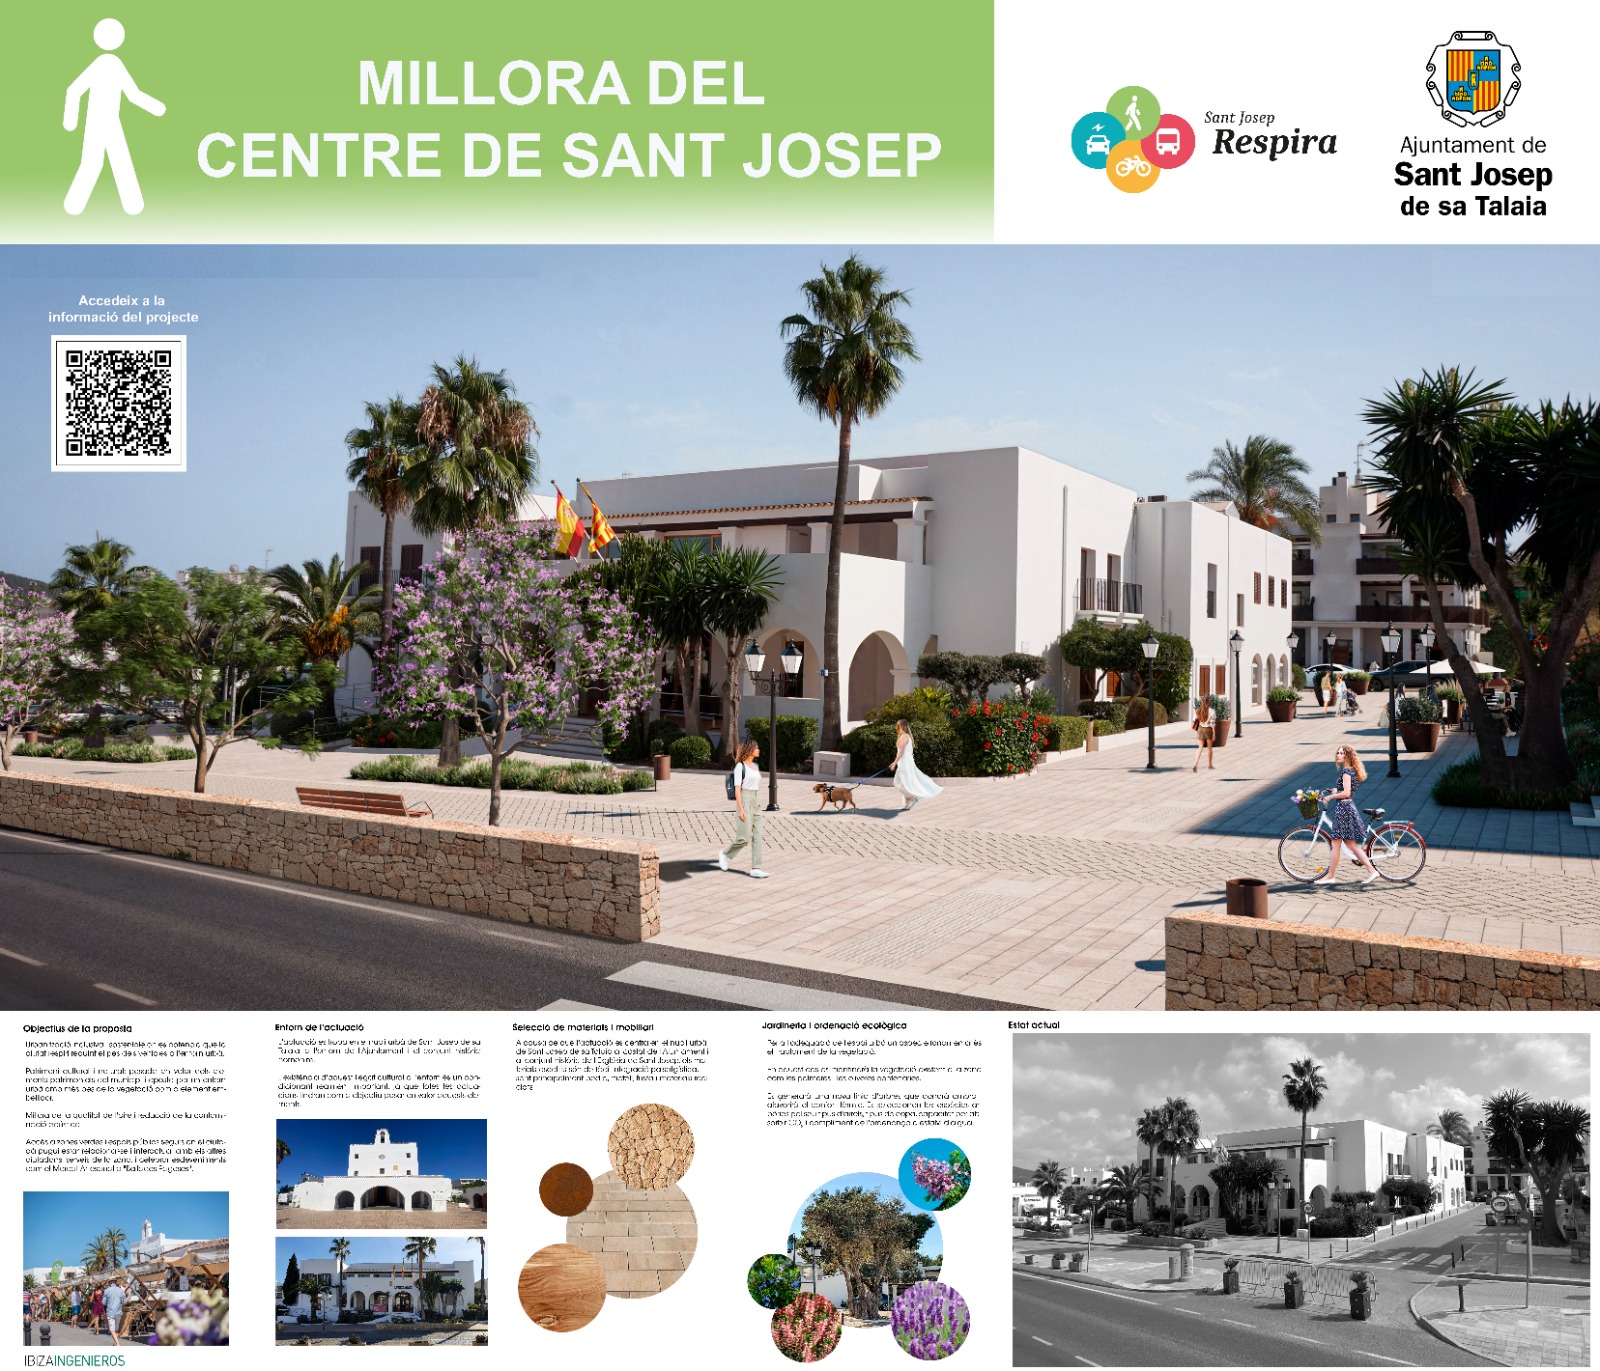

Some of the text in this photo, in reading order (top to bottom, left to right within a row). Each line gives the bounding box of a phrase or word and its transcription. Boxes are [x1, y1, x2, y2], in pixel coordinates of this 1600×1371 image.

[361, 60, 764, 105] MILLORA DEL
[1205, 111, 1275, 127] Sant Josep
[1212, 128, 1337, 161] Respira
[1401, 136, 1546, 157] Ajuntament de
[198, 133, 941, 178] CENTRE DE SANT JOSEP
[1394, 161, 1552, 191] Sant Josep
[1401, 196, 1546, 216] de sa Talaia
[23, 1025, 65, 1033] Objectius
[93, 1025, 132, 1033] proposta
[513, 1023, 550, 1031] Selecció
[814, 1021, 859, 1029] ordenació
[862, 1021, 907, 1030] ecològica
[1032, 1021, 1059, 1029] actual
[26, 1041, 71, 1049] Urbantzació
[74, 1041, 104, 1049] nclusiva
[133, 1137, 159, 1146] púbics
[25, 1355, 125, 1366] IBIZAINGENIEROS
